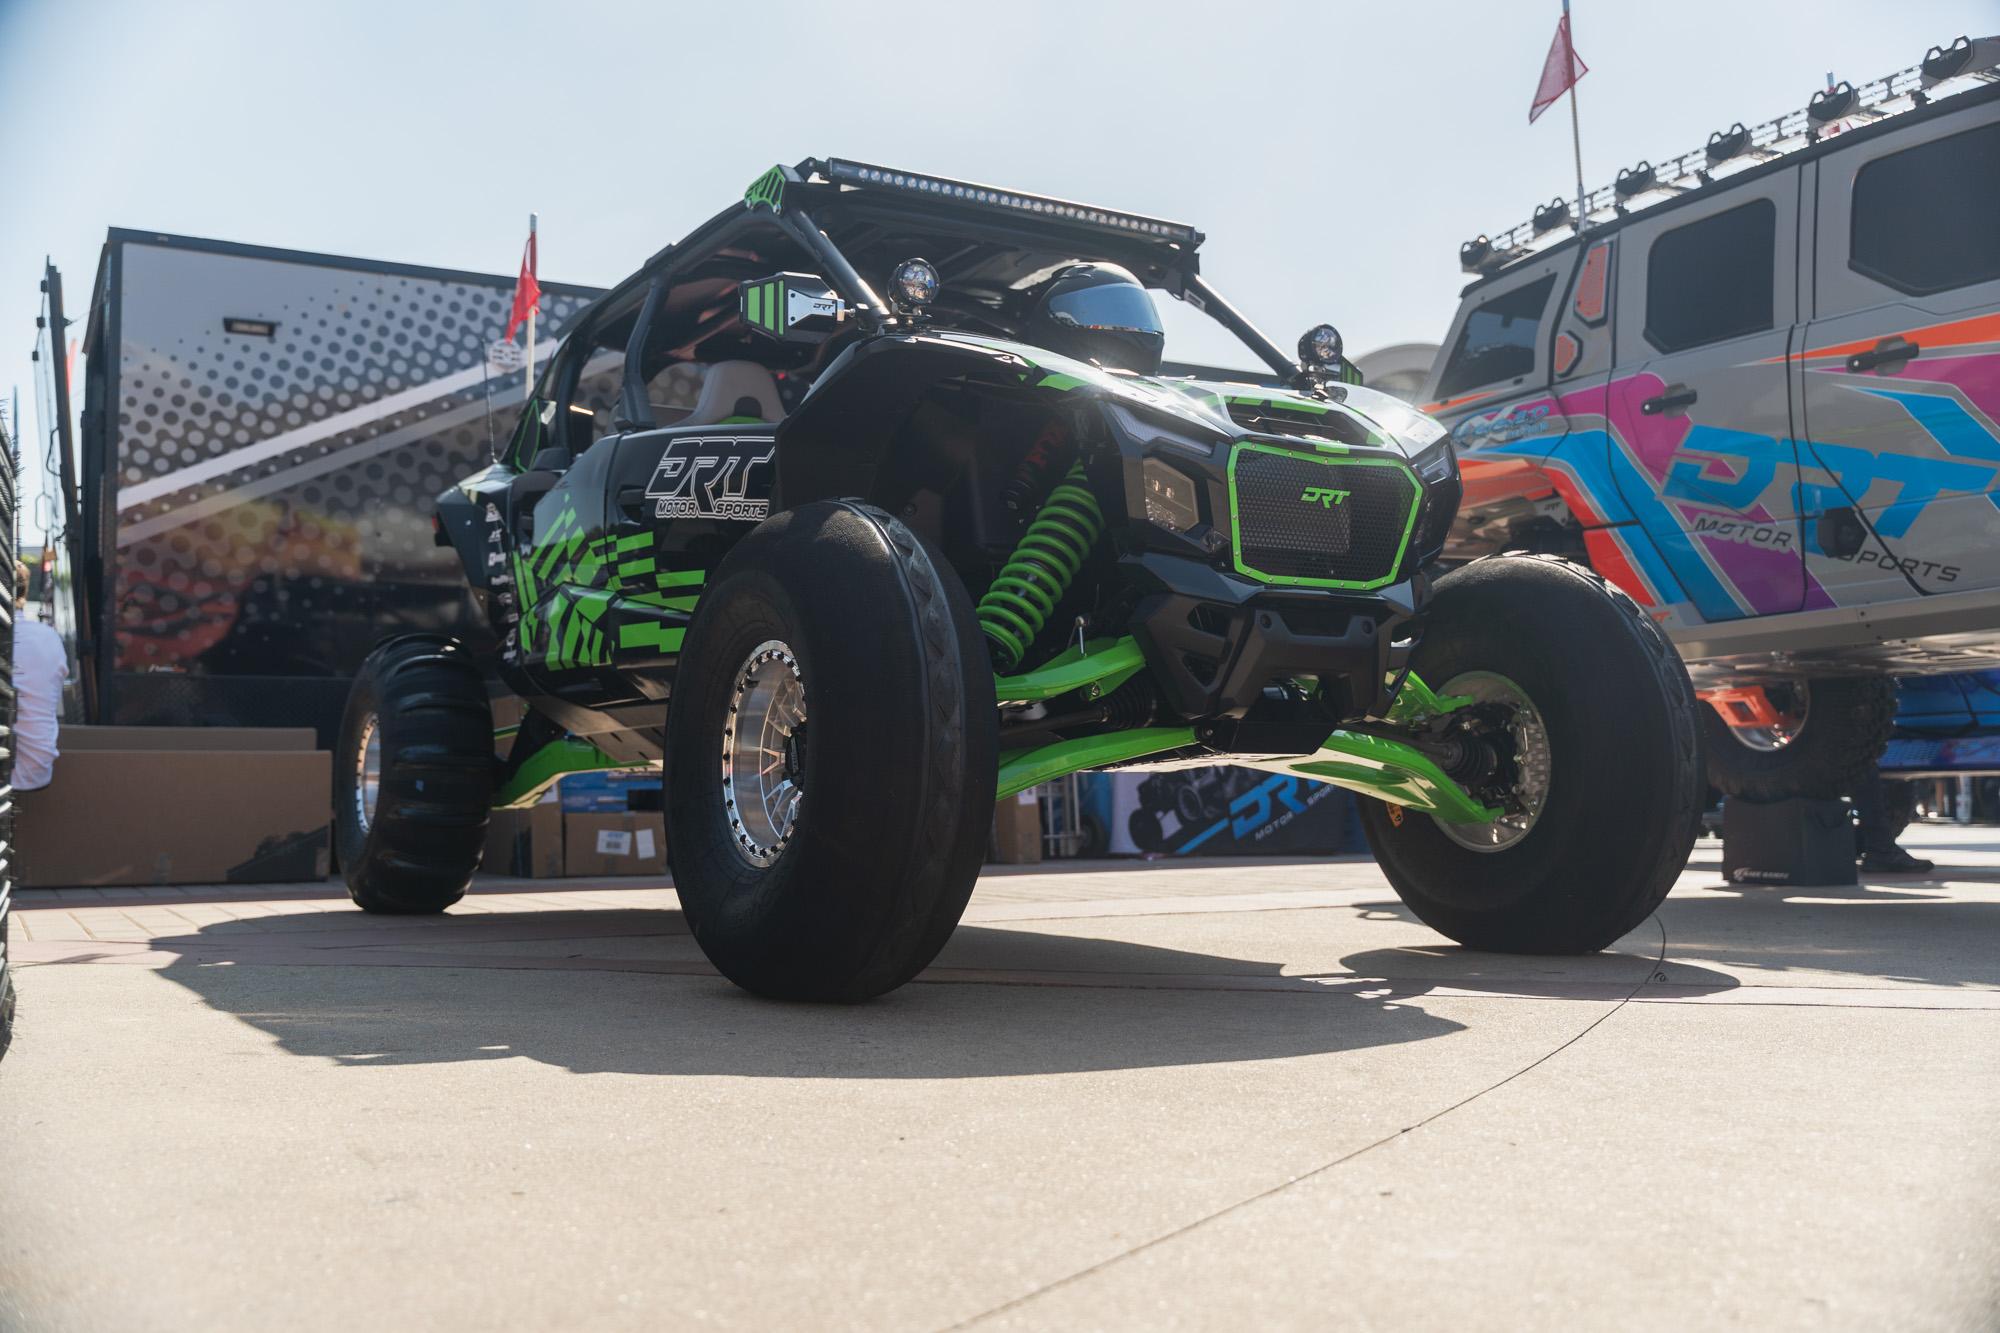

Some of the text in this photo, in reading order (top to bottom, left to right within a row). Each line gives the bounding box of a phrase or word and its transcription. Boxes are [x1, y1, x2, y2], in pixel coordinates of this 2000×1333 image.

[645, 436, 775, 516] DRT
[1662, 424, 1999, 556] DRT
[656, 499, 770, 519] MOTOR SPORTS
[1300, 486, 1352, 509] DRT
[1695, 517, 1792, 547] MOTOR
[1255, 812, 1294, 841] MOTOR
